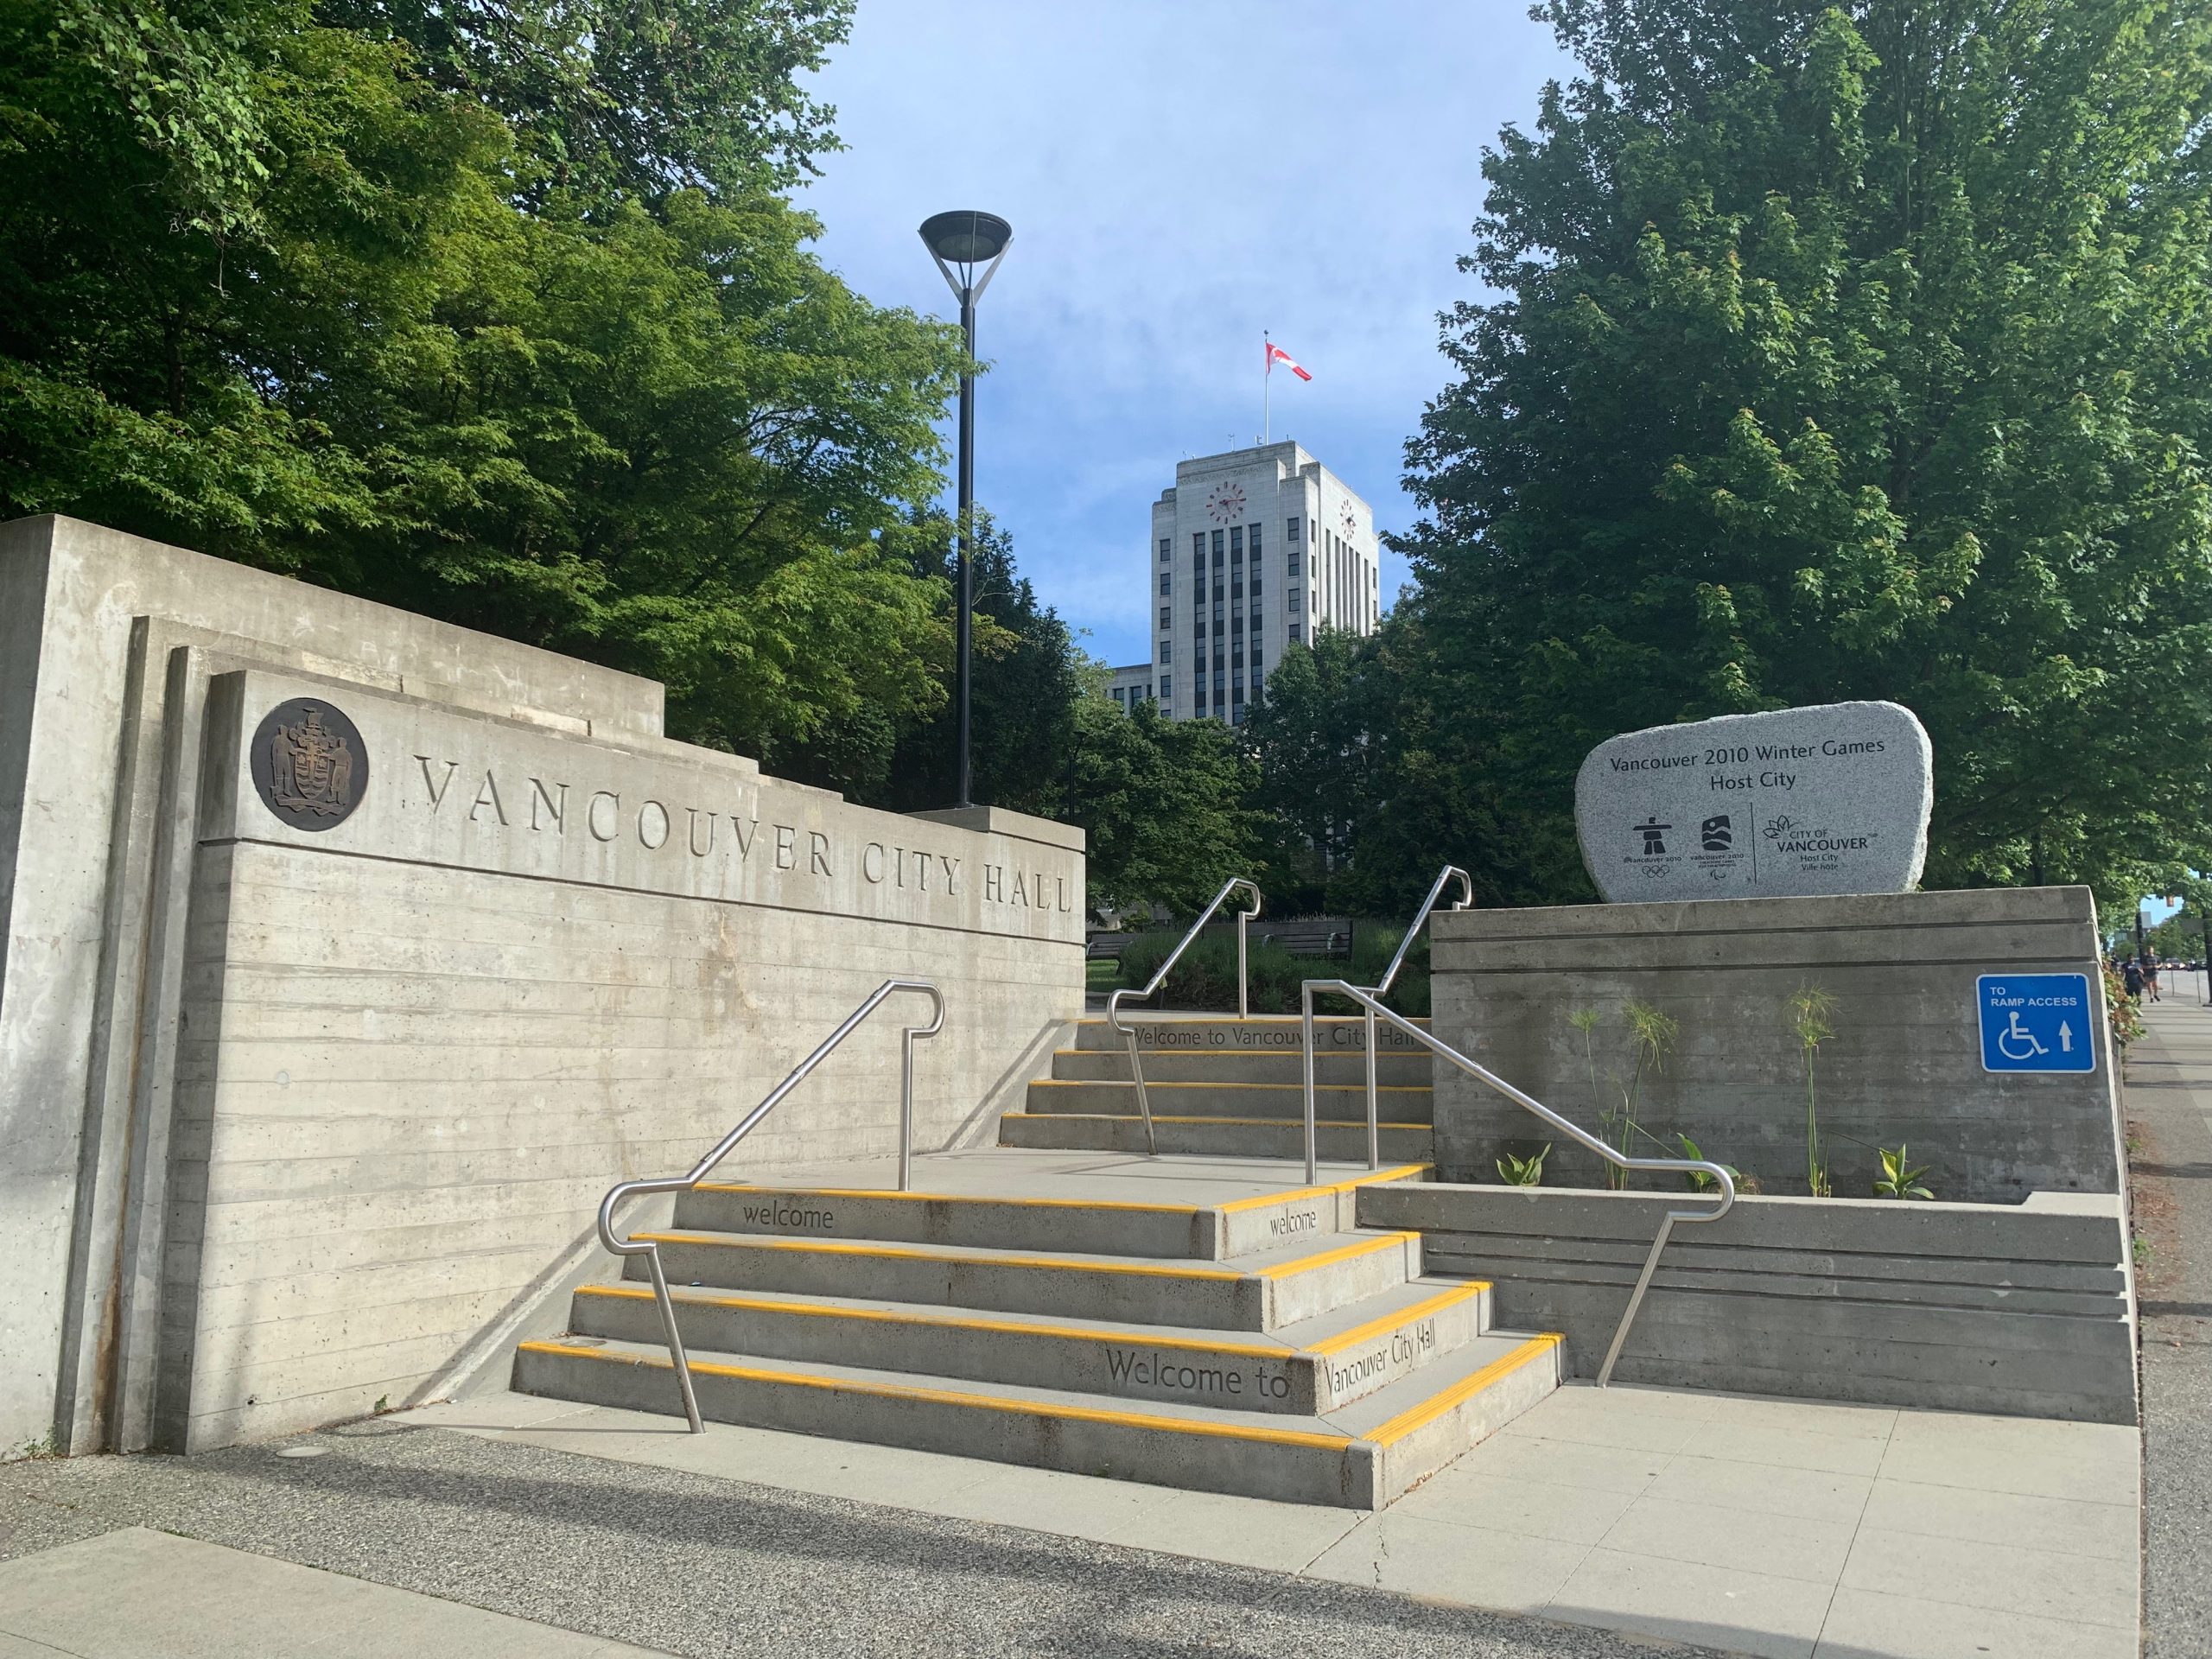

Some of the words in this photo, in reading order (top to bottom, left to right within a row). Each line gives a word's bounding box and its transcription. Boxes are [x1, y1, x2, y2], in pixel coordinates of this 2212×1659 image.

[1611, 755, 1698, 772] Vancouver
[1705, 747, 1749, 766] 2010
[1756, 745, 1815, 761] Winter
[1822, 740, 1885, 756] Games
[1711, 774, 1754, 791] Host
[1760, 772, 1796, 791] City
[412, 754, 833, 877] VANCOUVER
[863, 842, 961, 896] CITY
[983, 864, 1072, 912] HALL
[1789, 830, 1812, 839] CITY
[1815, 830, 1828, 838] OF
[1777, 837, 1868, 853] VANCOUVER
[1800, 854, 1820, 862] Host
[1821, 854, 1839, 862] City
[1989, 987, 2006, 995] TO
[1991, 998, 2025, 1007] RAMP
[2028, 997, 2077, 1007] ACCESS
[1207, 1028, 1225, 1045] to
[1232, 1027, 1325, 1045] Vancouvr
[743, 1199, 834, 1229] welcome
[1270, 1207, 1316, 1236] welcome
[1325, 1349, 1387, 1396] Vancouver
[1392, 1333, 1414, 1368] City
[1417, 1318, 1435, 1354] Hall
[1106, 1349, 1242, 1394] Welcome
[1255, 1366, 1290, 1398] to
